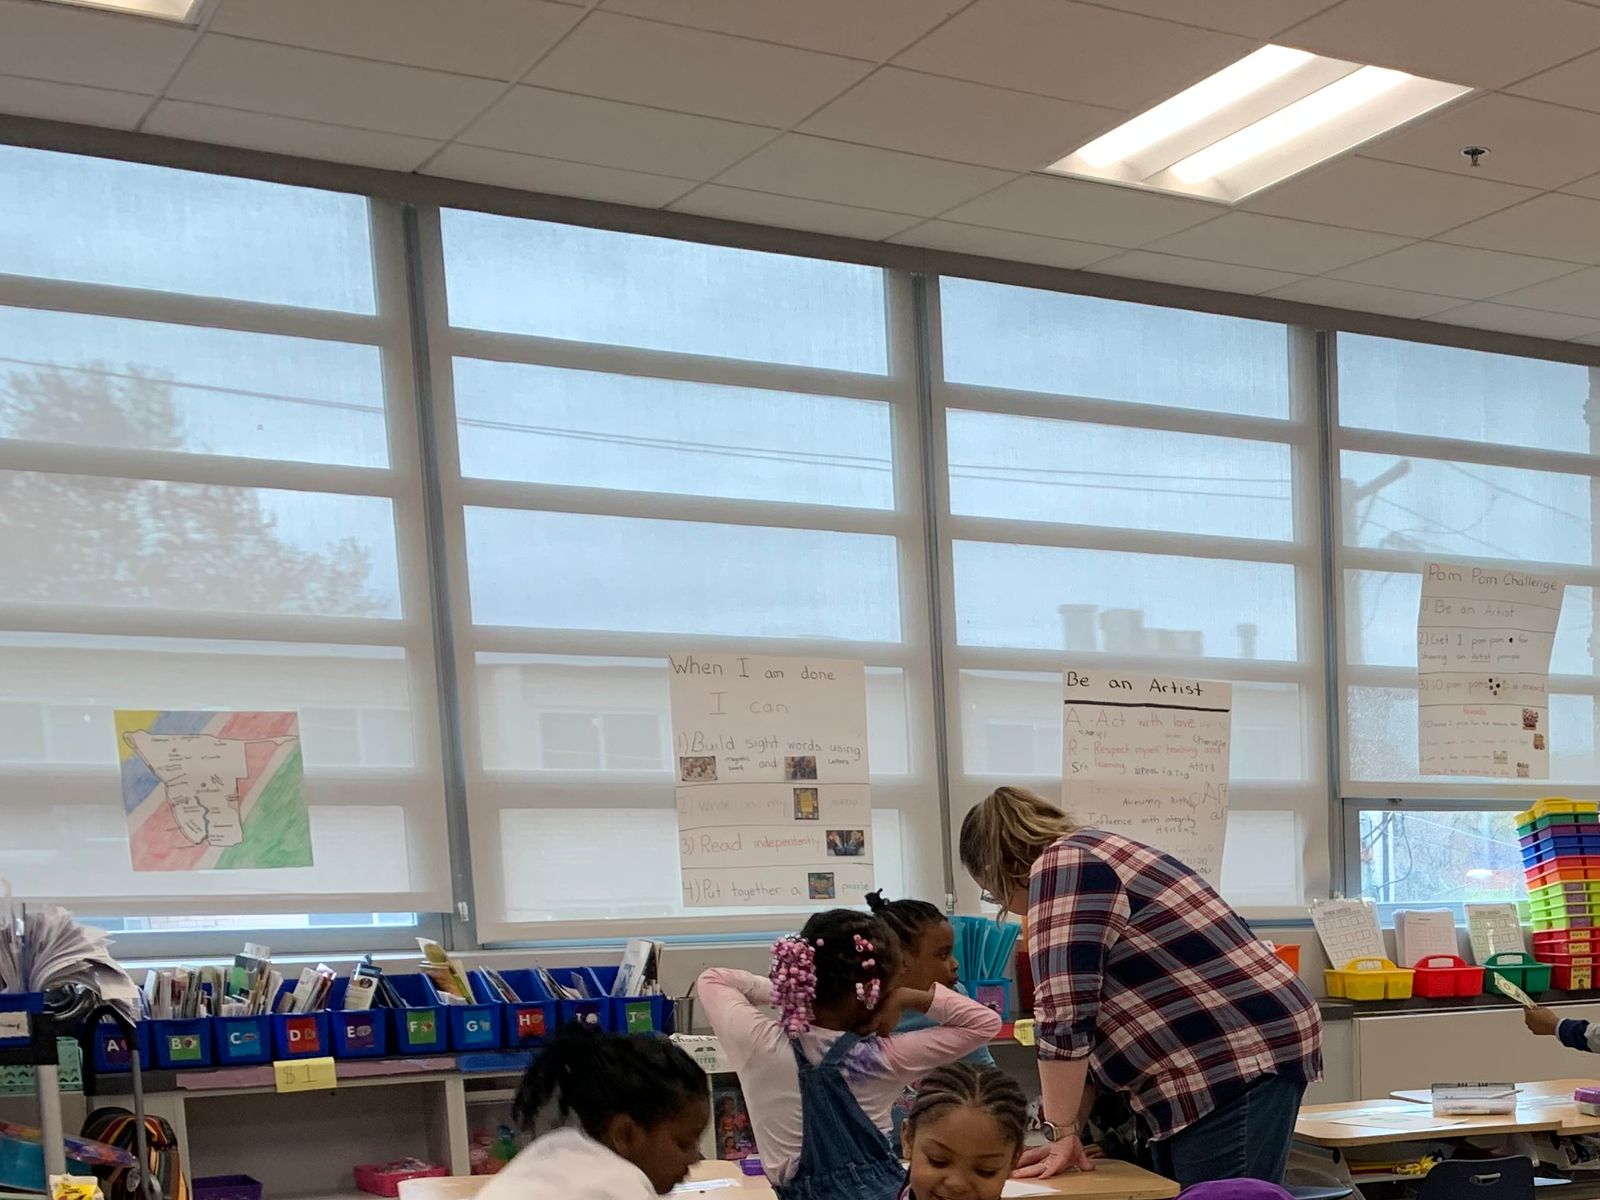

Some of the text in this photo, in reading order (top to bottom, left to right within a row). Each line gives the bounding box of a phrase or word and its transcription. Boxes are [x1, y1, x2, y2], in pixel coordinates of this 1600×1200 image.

[1427, 563, 1558, 595] Pom Pom Challenge
[1434, 599, 1452, 614] Be
[1461, 605, 1476, 615] an
[1430, 634, 1449, 645] Get
[667, 654, 836, 681] When I am done
[1067, 671, 1204, 697] Be an Artist
[709, 691, 790, 716] I can
[1065, 707, 1081, 728] A
[1137, 711, 1163, 727] with
[1173, 712, 1196, 728] love
[745, 736, 779, 753] sight
[787, 740, 822, 752] words
[829, 745, 861, 761] using
[1068, 738, 1078, 755] R
[758, 758, 777, 769] and
[701, 831, 743, 853] Read
[730, 880, 781, 902] together
[791, 886, 801, 896] a
[519, 1014, 531, 1026] H
[629, 1011, 636, 1024] J
[346, 1026, 356, 1038] E
[409, 1021, 417, 1033] F
[466, 1020, 478, 1032] G
[230, 1032, 241, 1044] C
[289, 1029, 301, 1041] D
[106, 1039, 119, 1052] A
[171, 1038, 182, 1050] B
